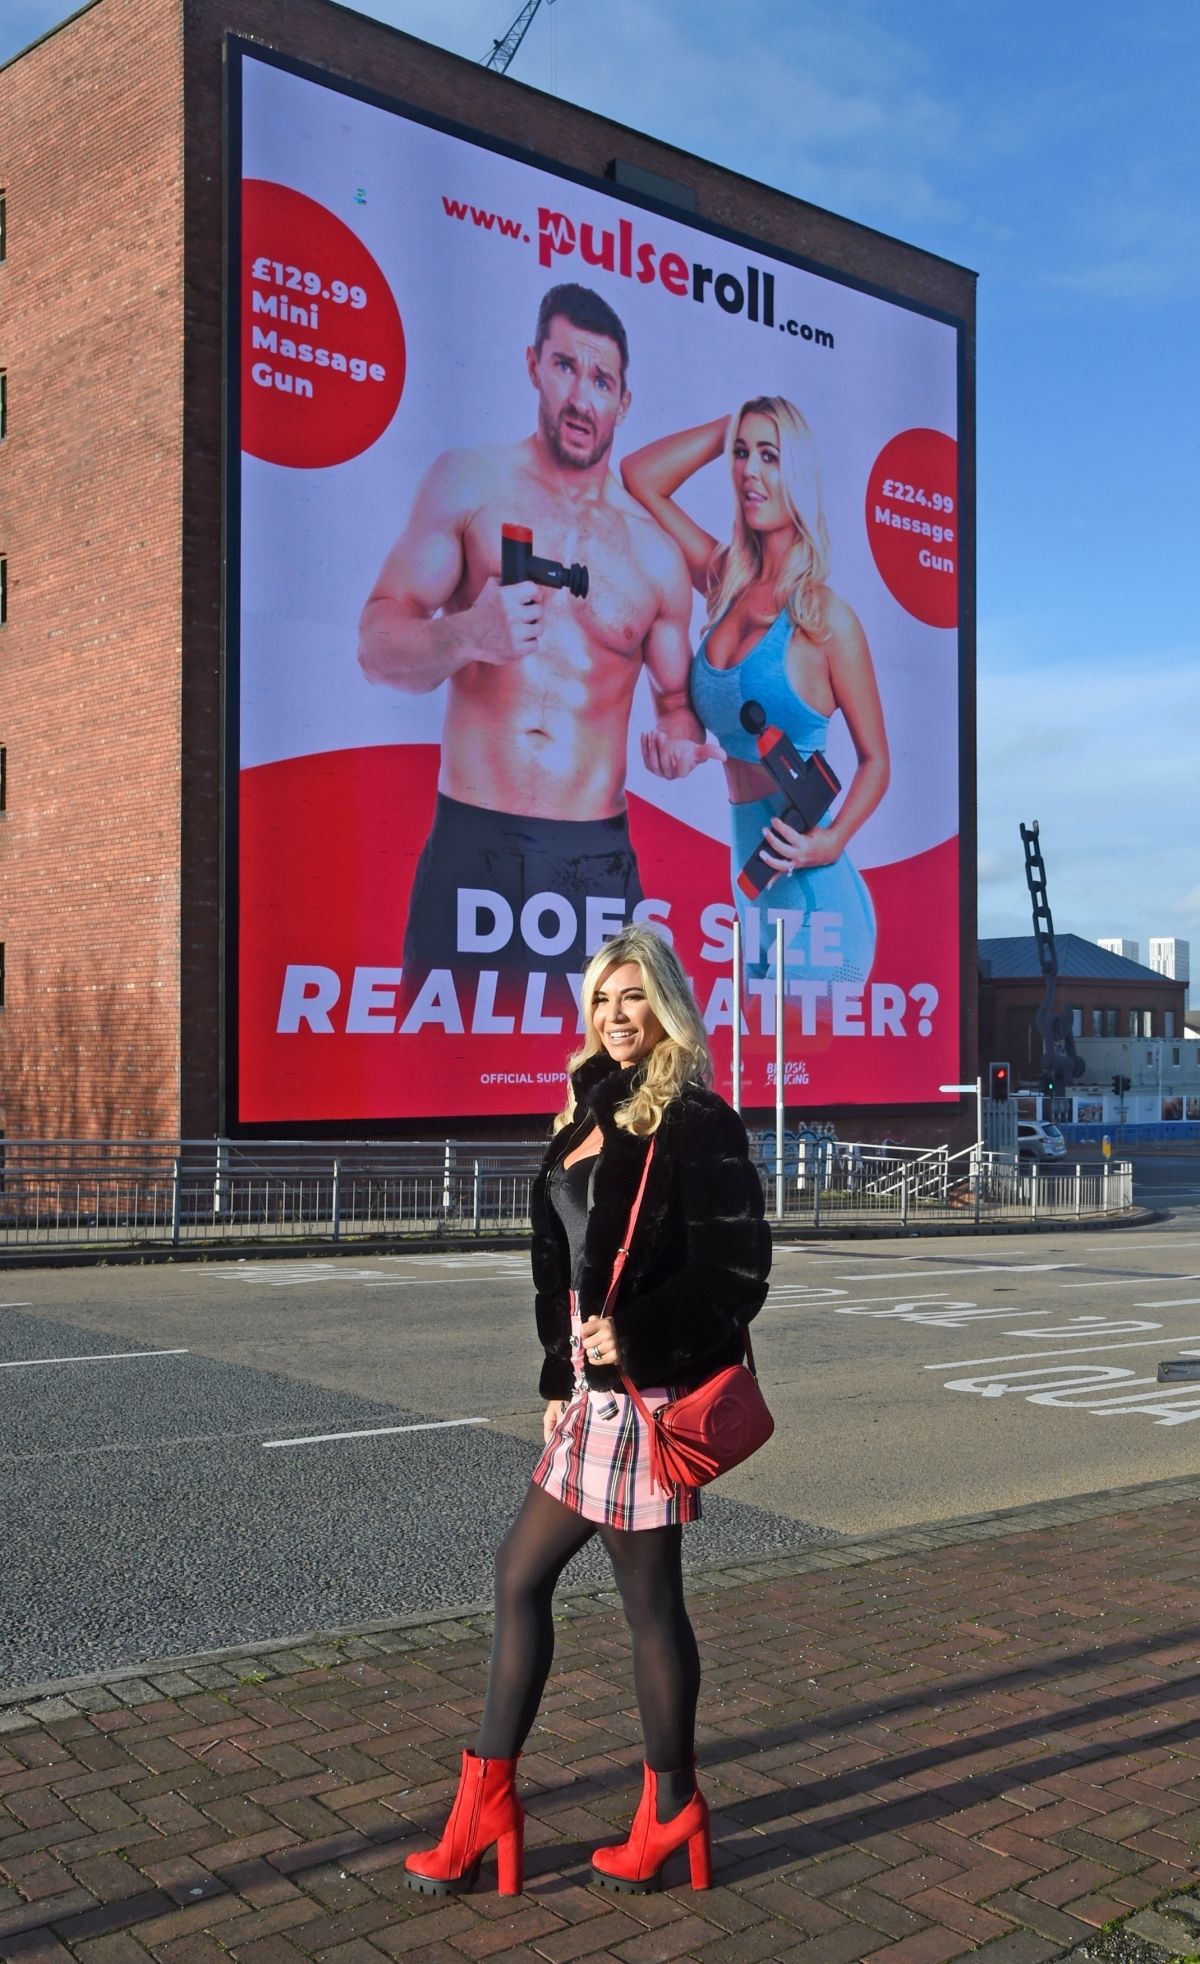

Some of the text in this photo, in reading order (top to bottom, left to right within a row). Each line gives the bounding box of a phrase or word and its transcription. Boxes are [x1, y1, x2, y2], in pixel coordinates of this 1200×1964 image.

[252, 257, 367, 309] £129.99
[252, 290, 318, 329] Mini
[252, 325, 386, 382] Massage
[252, 363, 313, 398] Gun
[882, 479, 954, 513] £224.99
[875, 506, 954, 542] Massage
[919, 549, 954, 573] Gun
[457, 888, 844, 965] DOES SIZE
[683, 976, 939, 1037] ATTER?
[480, 1073, 534, 1084] OFFICIAL
